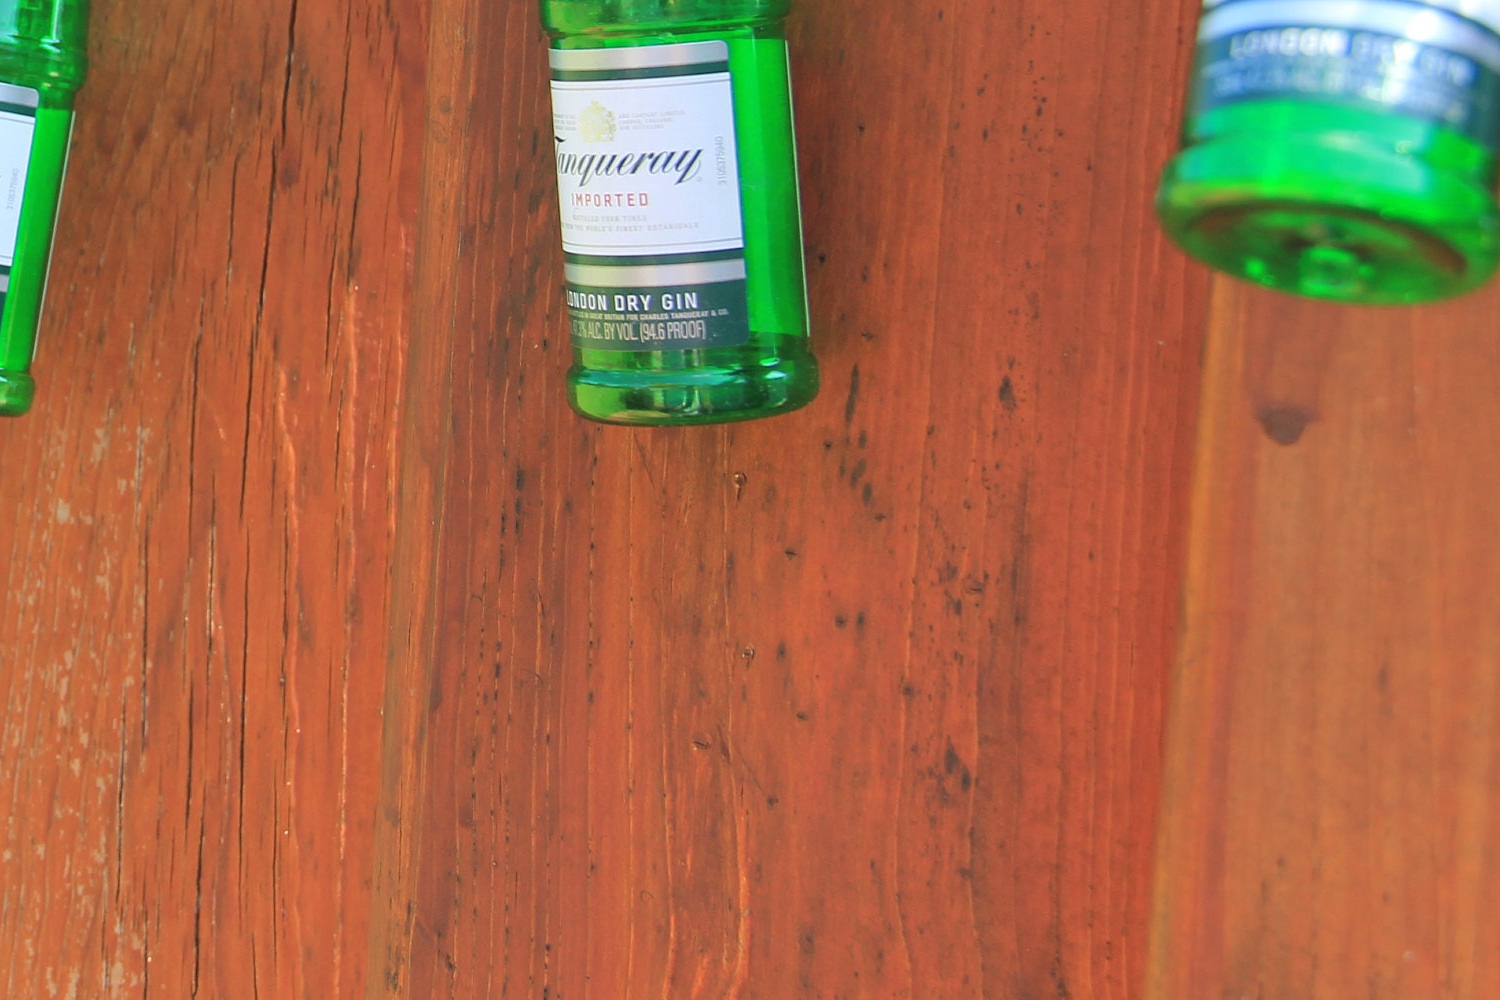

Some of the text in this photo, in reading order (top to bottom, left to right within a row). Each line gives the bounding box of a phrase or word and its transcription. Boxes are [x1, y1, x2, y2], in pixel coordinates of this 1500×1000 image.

[571, 193, 649, 207] IMPORTED
[614, 294, 652, 312] DRY
[661, 292, 698, 311] GIN
[604, 322, 616, 340] BY
[615, 323, 638, 341] VOL.
[640, 321, 665, 343] (94.6
[667, 319, 706, 341] PROOF)
